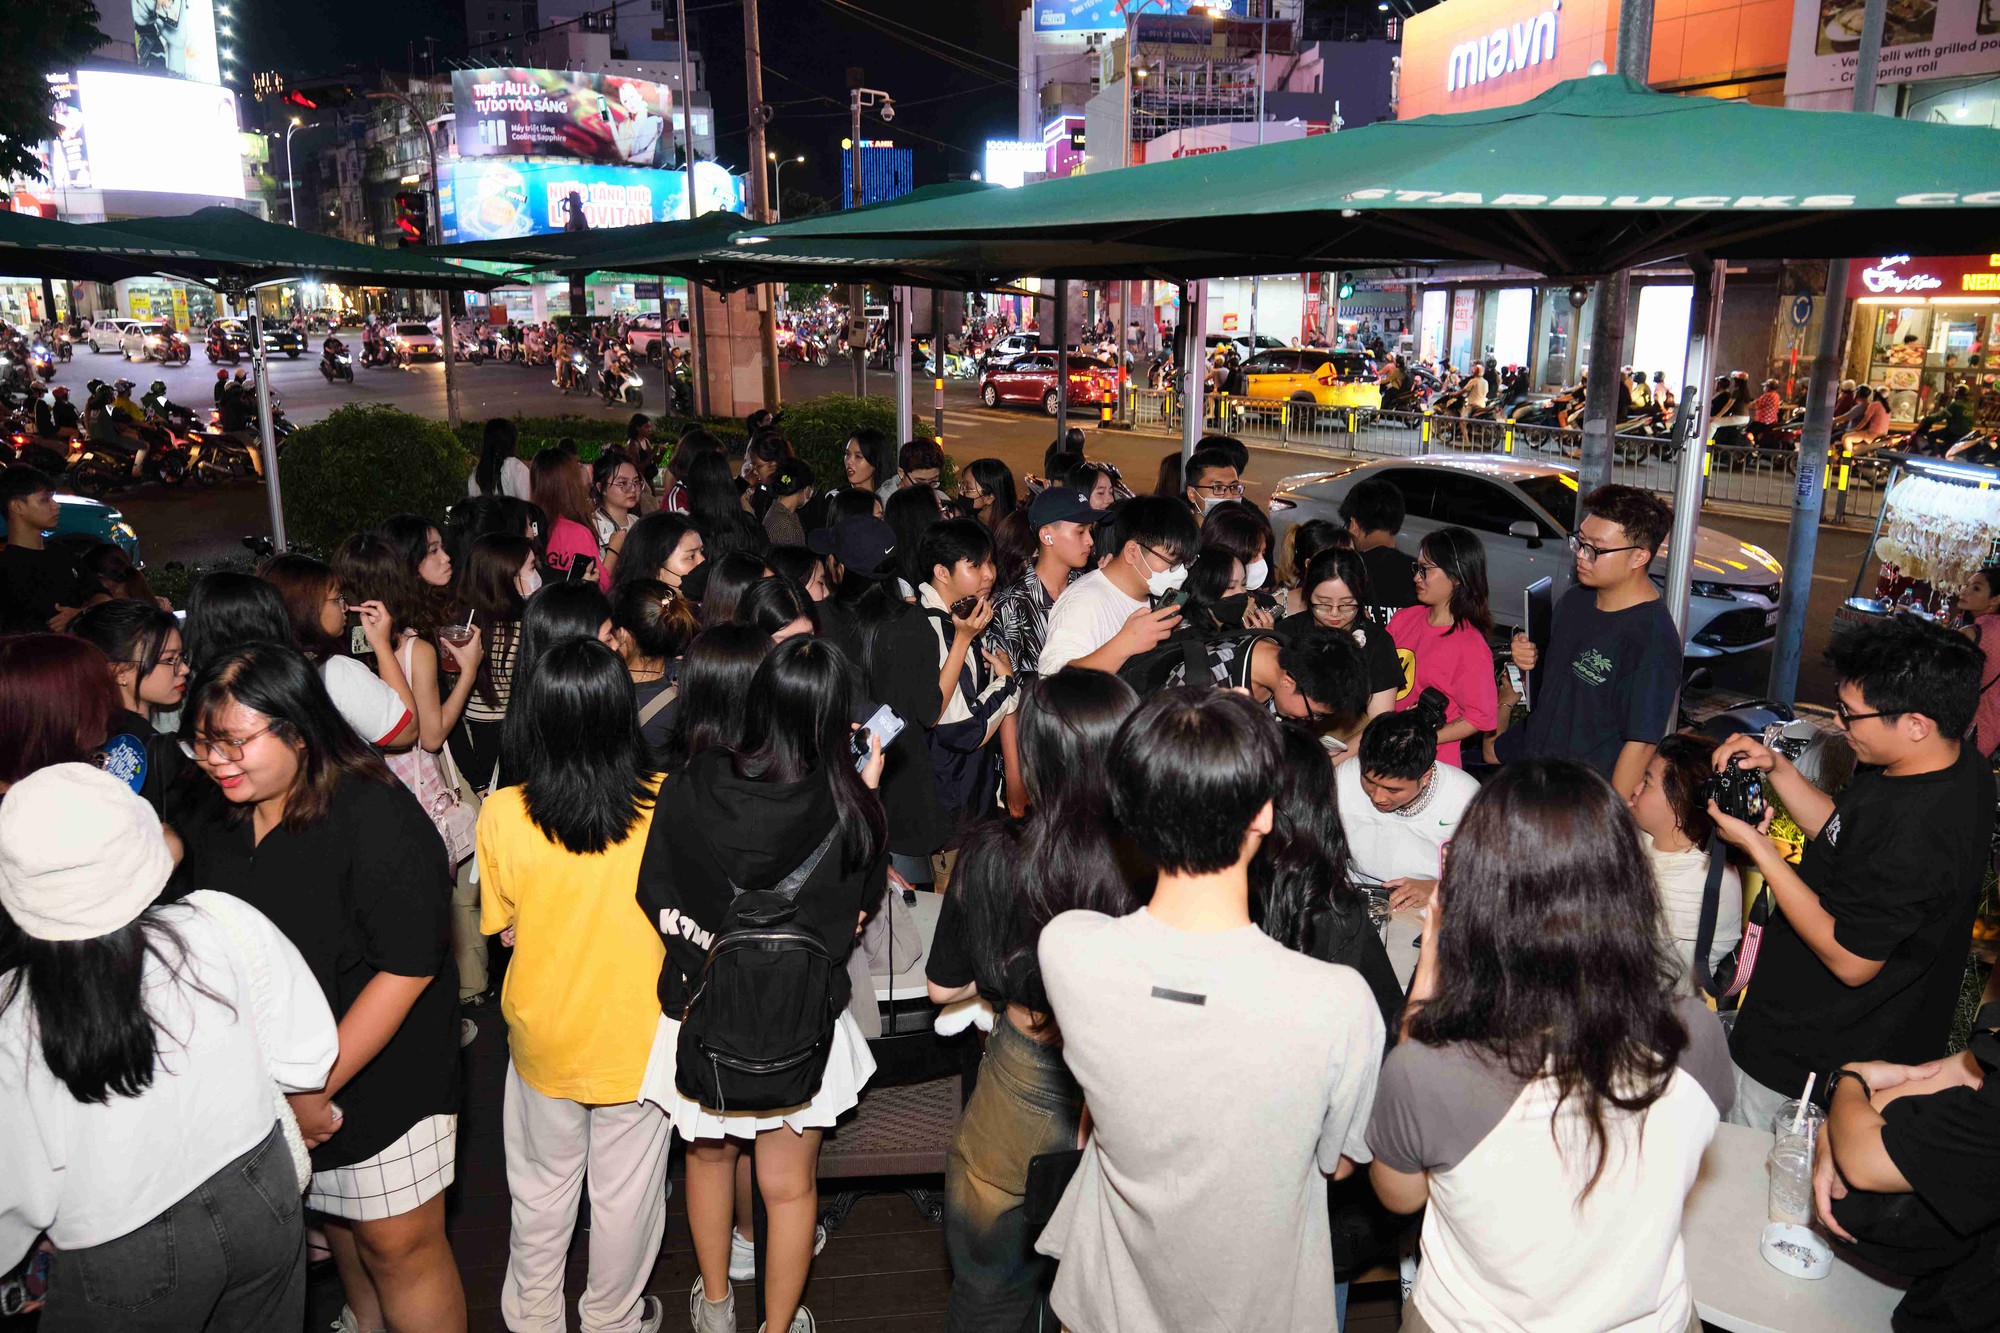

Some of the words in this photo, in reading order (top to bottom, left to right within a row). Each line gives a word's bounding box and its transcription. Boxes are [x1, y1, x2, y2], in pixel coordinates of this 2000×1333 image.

[1447, 9, 1557, 92] mia.vn
[1904, 46, 1931, 59] with
[1934, 40, 1977, 58] grilled
[1916, 61, 1938, 73] roll
[522, 83, 540, 96] LO
[534, 97, 568, 113] SÁNG
[1351, 188, 1857, 208] STARBUCKS
[702, 250, 854, 263] STARBUCKS
[1962, 274, 2000, 291] NEM
